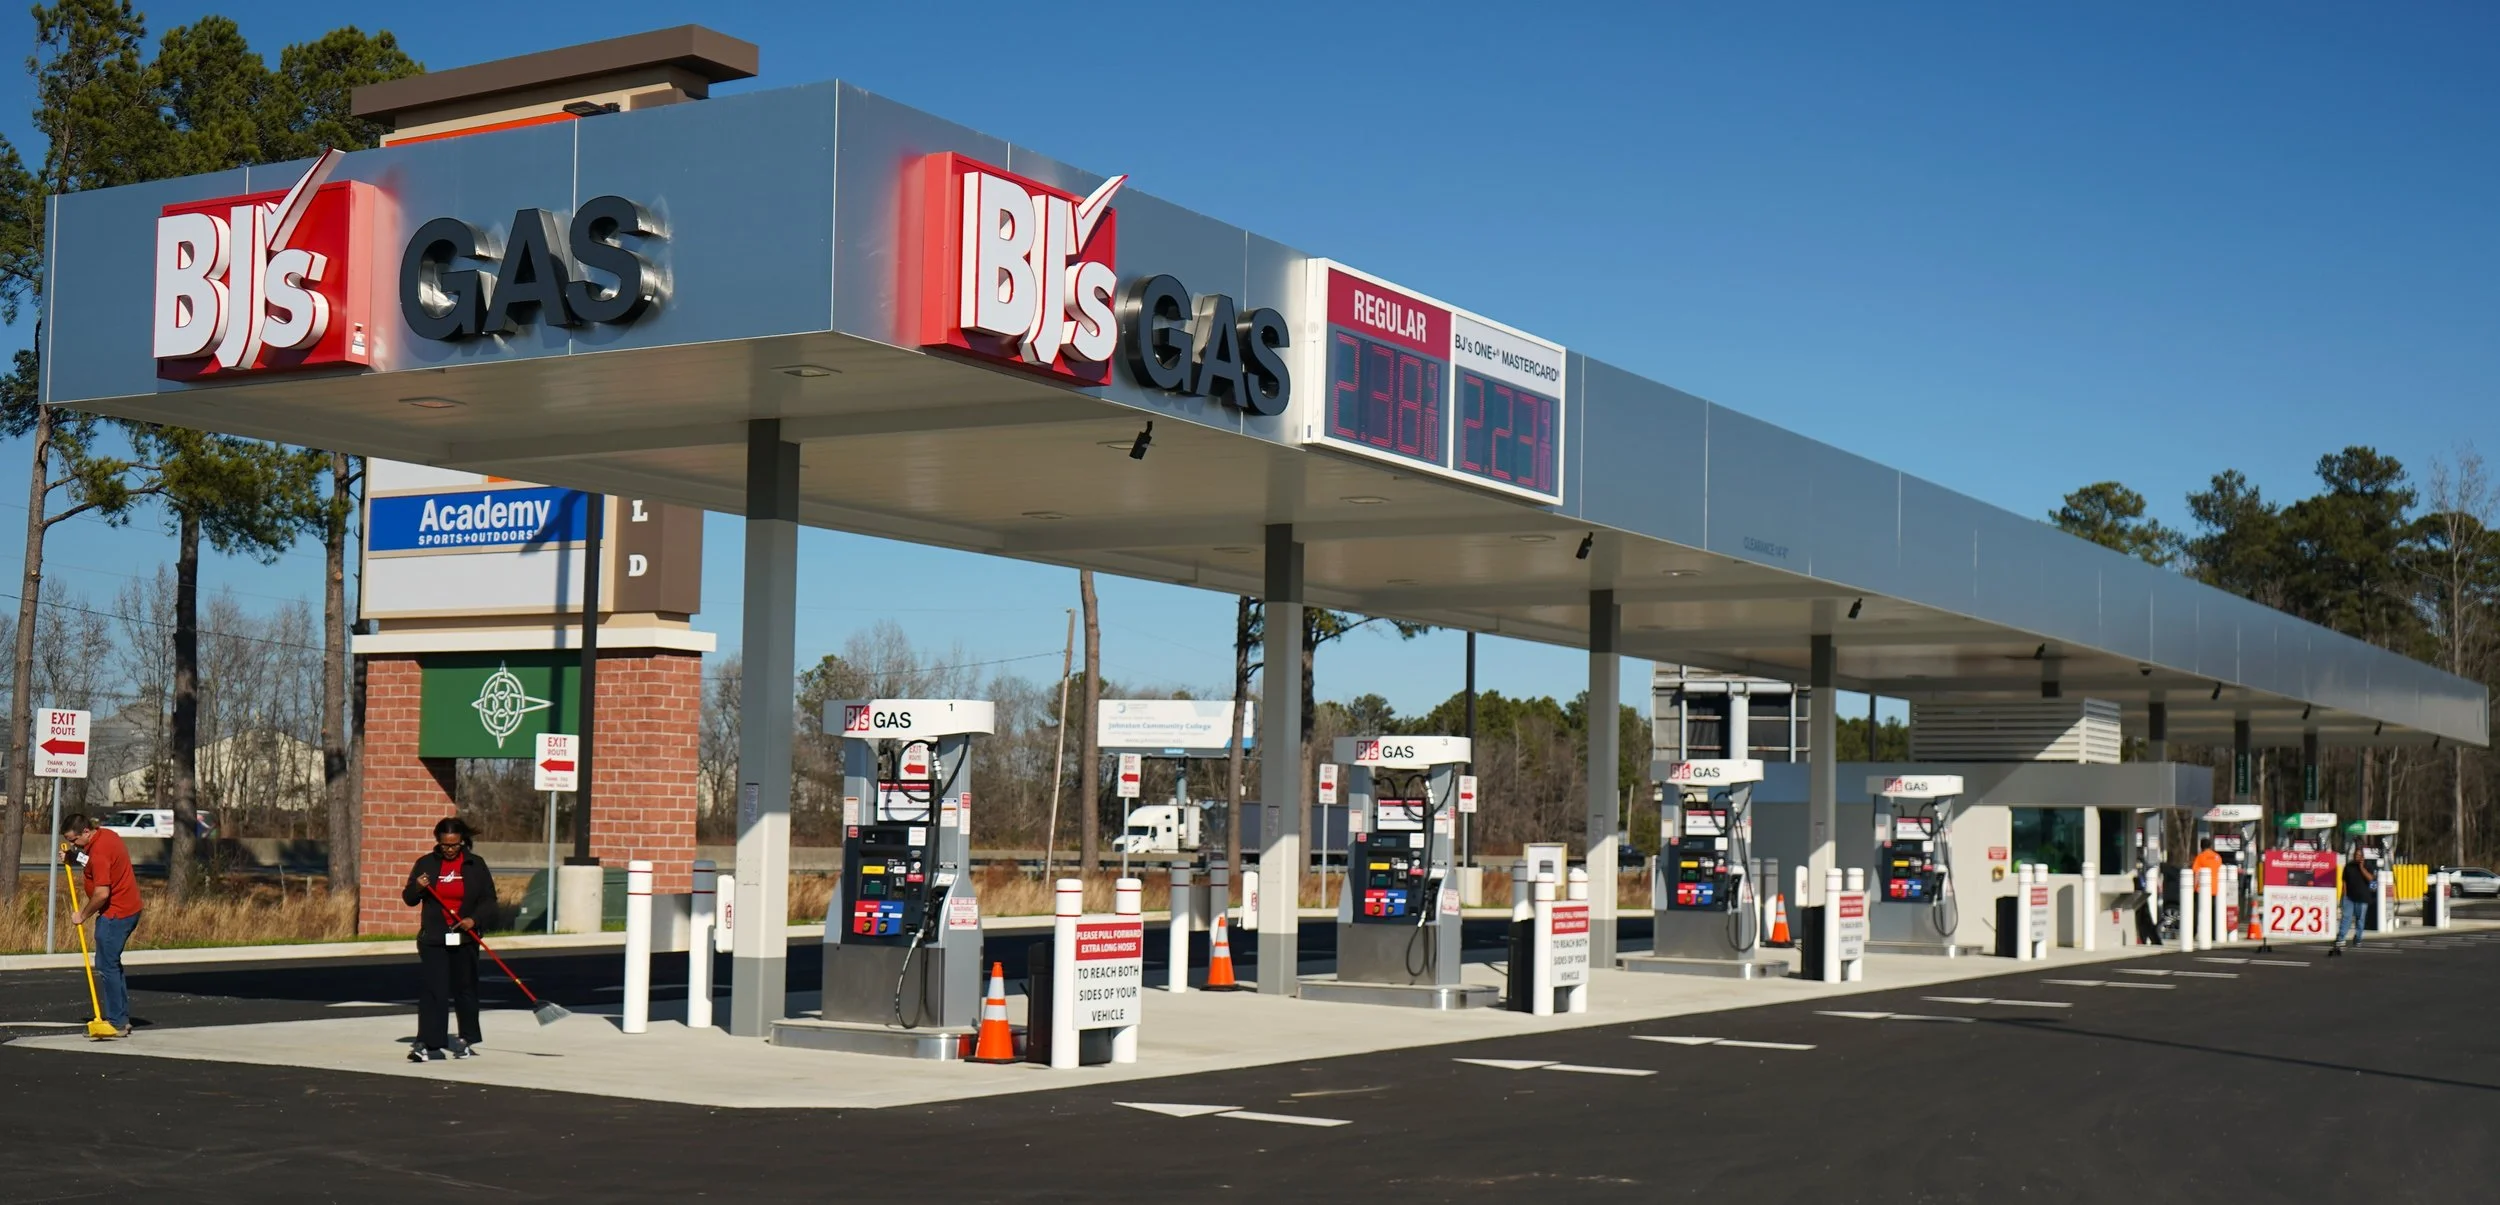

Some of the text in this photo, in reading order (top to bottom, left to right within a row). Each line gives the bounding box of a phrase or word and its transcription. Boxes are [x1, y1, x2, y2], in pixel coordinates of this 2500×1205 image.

[399, 195, 656, 341] GAS
[1353, 289, 1427, 344] REGULAR
[1126, 273, 1291, 417] GAS
[418, 494, 552, 535] Academy
[948, 703, 954, 712] 1
[51, 711, 77, 726] EXIT
[873, 711, 912, 729] GAS
[50, 726, 76, 736] ROUTE
[1142, 721, 1184, 731] Community
[1185, 722, 1212, 731] College
[547, 736, 568, 748] EXIT
[1382, 745, 1415, 759] GAS
[1693, 767, 1721, 778] GAS
[1904, 780, 1928, 791] GAS
[1076, 928, 1141, 940] PLEASE PULL FORWARD
[1081, 942, 1136, 953] EXTRA LONG HOSES
[1078, 965, 1139, 980] TO REACH BOTH
[1079, 986, 1137, 1001] SIDES OF YOUR
[1091, 1008, 1124, 1022] VEHICLE
